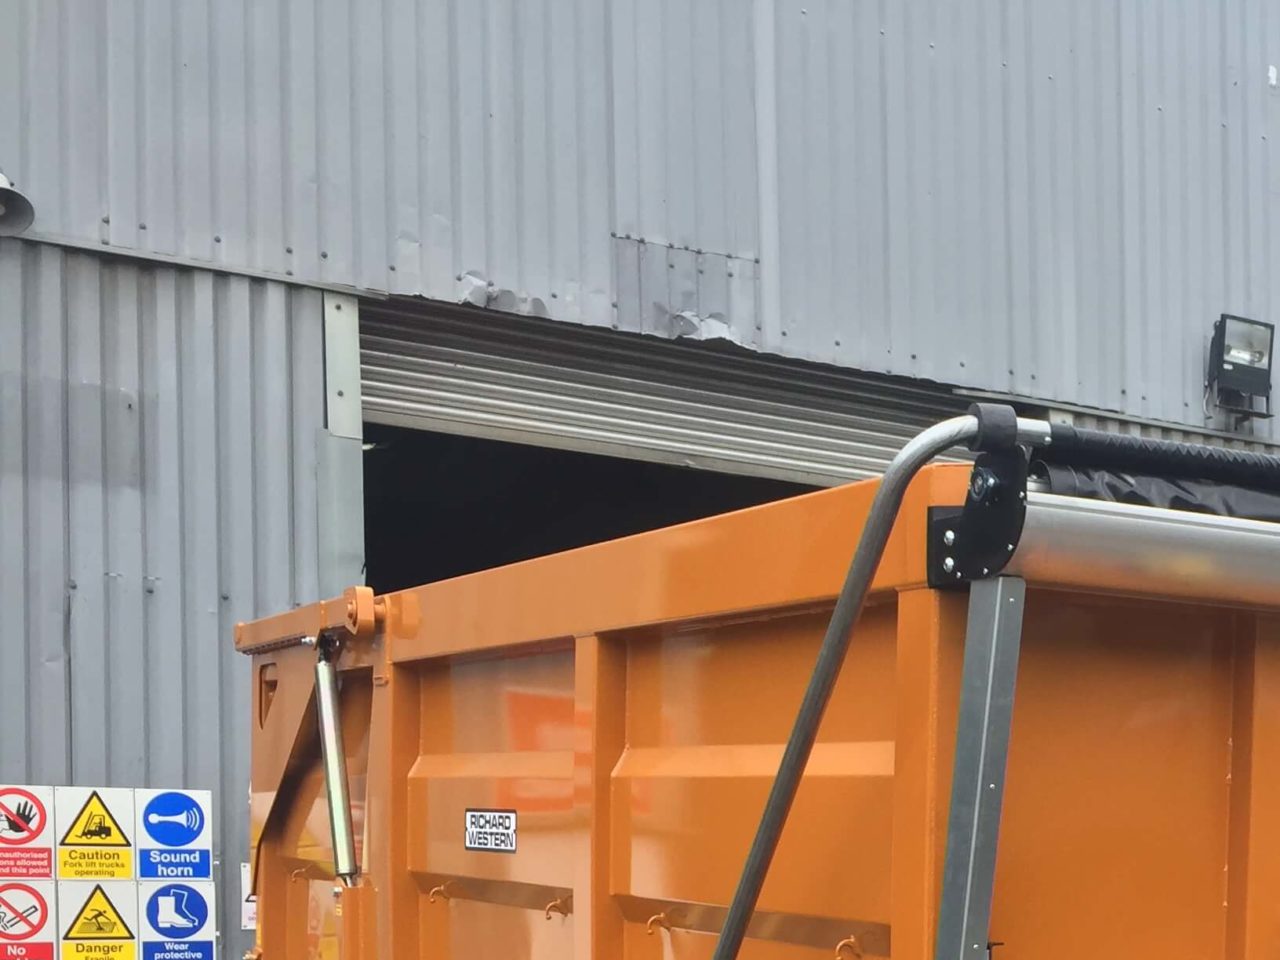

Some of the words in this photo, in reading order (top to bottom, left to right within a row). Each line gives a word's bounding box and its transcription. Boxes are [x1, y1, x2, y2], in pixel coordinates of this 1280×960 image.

[470, 814, 512, 830] RICHARD
[468, 831, 514, 847] WESTERN
[68, 849, 120, 860] Caution
[150, 850, 200, 863] Sound
[16, 859, 48, 867] allowed
[29, 867, 50, 875] point
[157, 864, 193, 876] horn
[7, 945, 26, 956] No
[75, 943, 124, 955] Danger
[164, 942, 189, 951] Wear
[154, 951, 203, 960] protective
